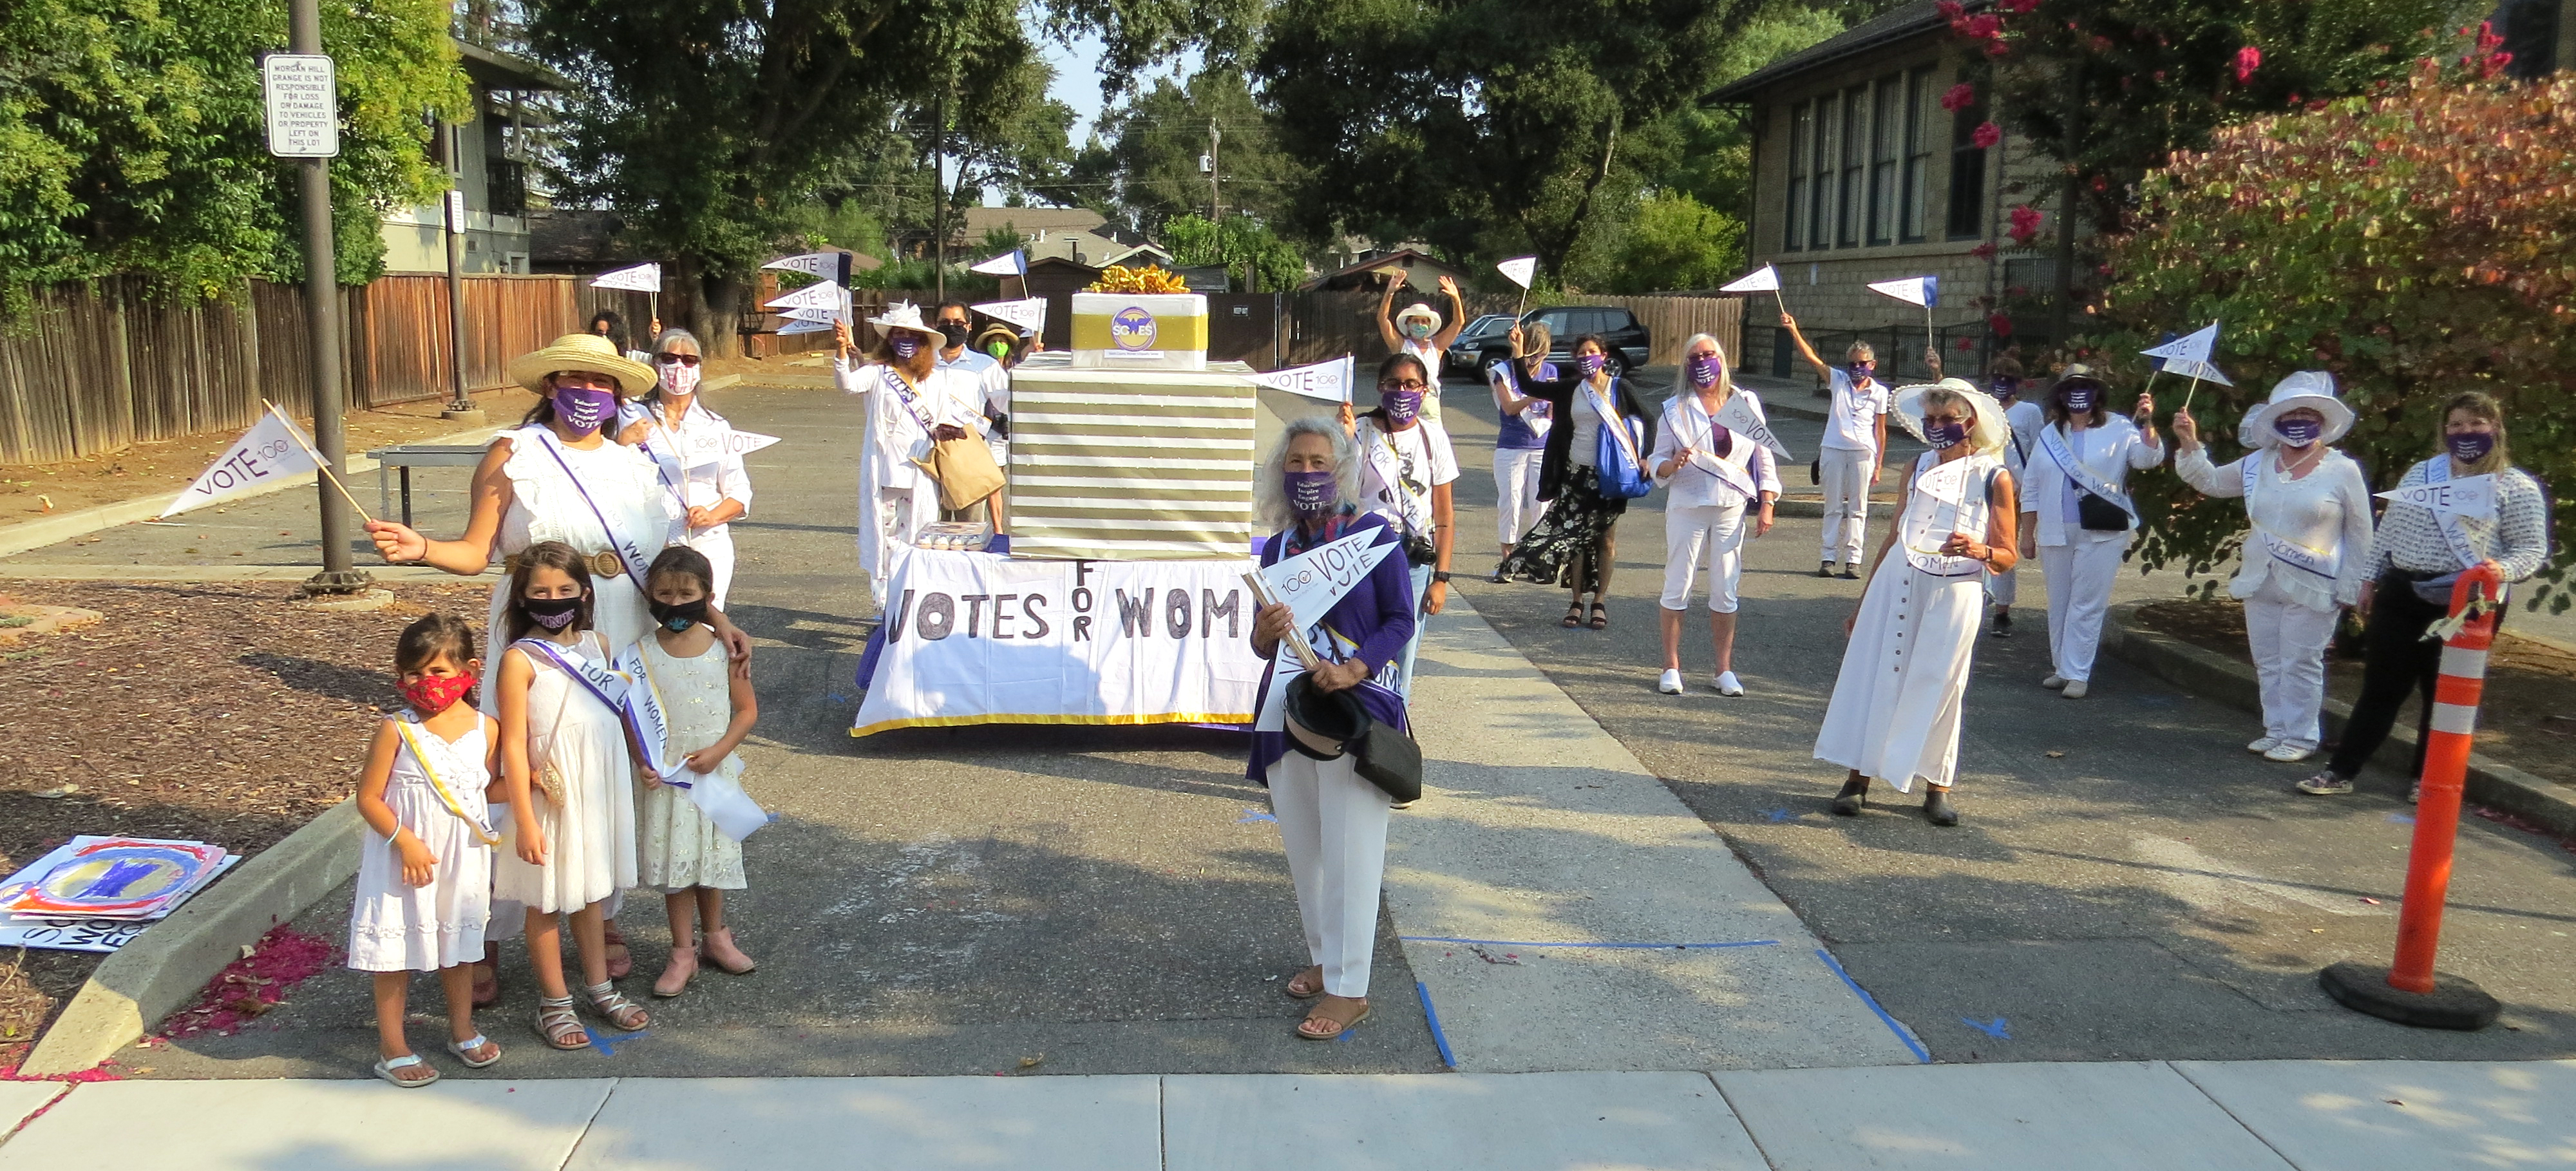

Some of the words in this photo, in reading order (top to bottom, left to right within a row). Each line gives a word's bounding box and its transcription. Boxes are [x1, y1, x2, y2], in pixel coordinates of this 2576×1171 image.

[782, 258, 818, 272] VOTE
[611, 271, 637, 283] VOTE
[1734, 277, 1757, 289] VOTE
[783, 290, 819, 305] VOTE
[1882, 283, 1909, 297] VOTE
[987, 305, 1019, 320] VOTE
[2159, 339, 2190, 356] VOTE
[1267, 370, 1314, 392] VOTE
[1316, 374, 1340, 385] 100
[2188, 361, 2219, 380] VOTE
[883, 364, 918, 403] VOTES
[567, 414, 601, 428] VOTE
[1390, 409, 1414, 419] VOTE
[721, 433, 762, 455] VOTE
[1745, 419, 1777, 450] VOTE
[196, 448, 269, 496] VOTE
[257, 439, 288, 461] 100
[1372, 444, 1391, 470] FOR
[2401, 486, 2451, 506] VOTE
[2264, 533, 2315, 566] Women
[1281, 569, 1312, 595] 100
[1308, 537, 1366, 582] VOTE
[888, 589, 1050, 645] VOTES
[1072, 560, 1094, 642] FOR
[580, 660, 614, 691] FOR
[630, 657, 647, 685] FOR
